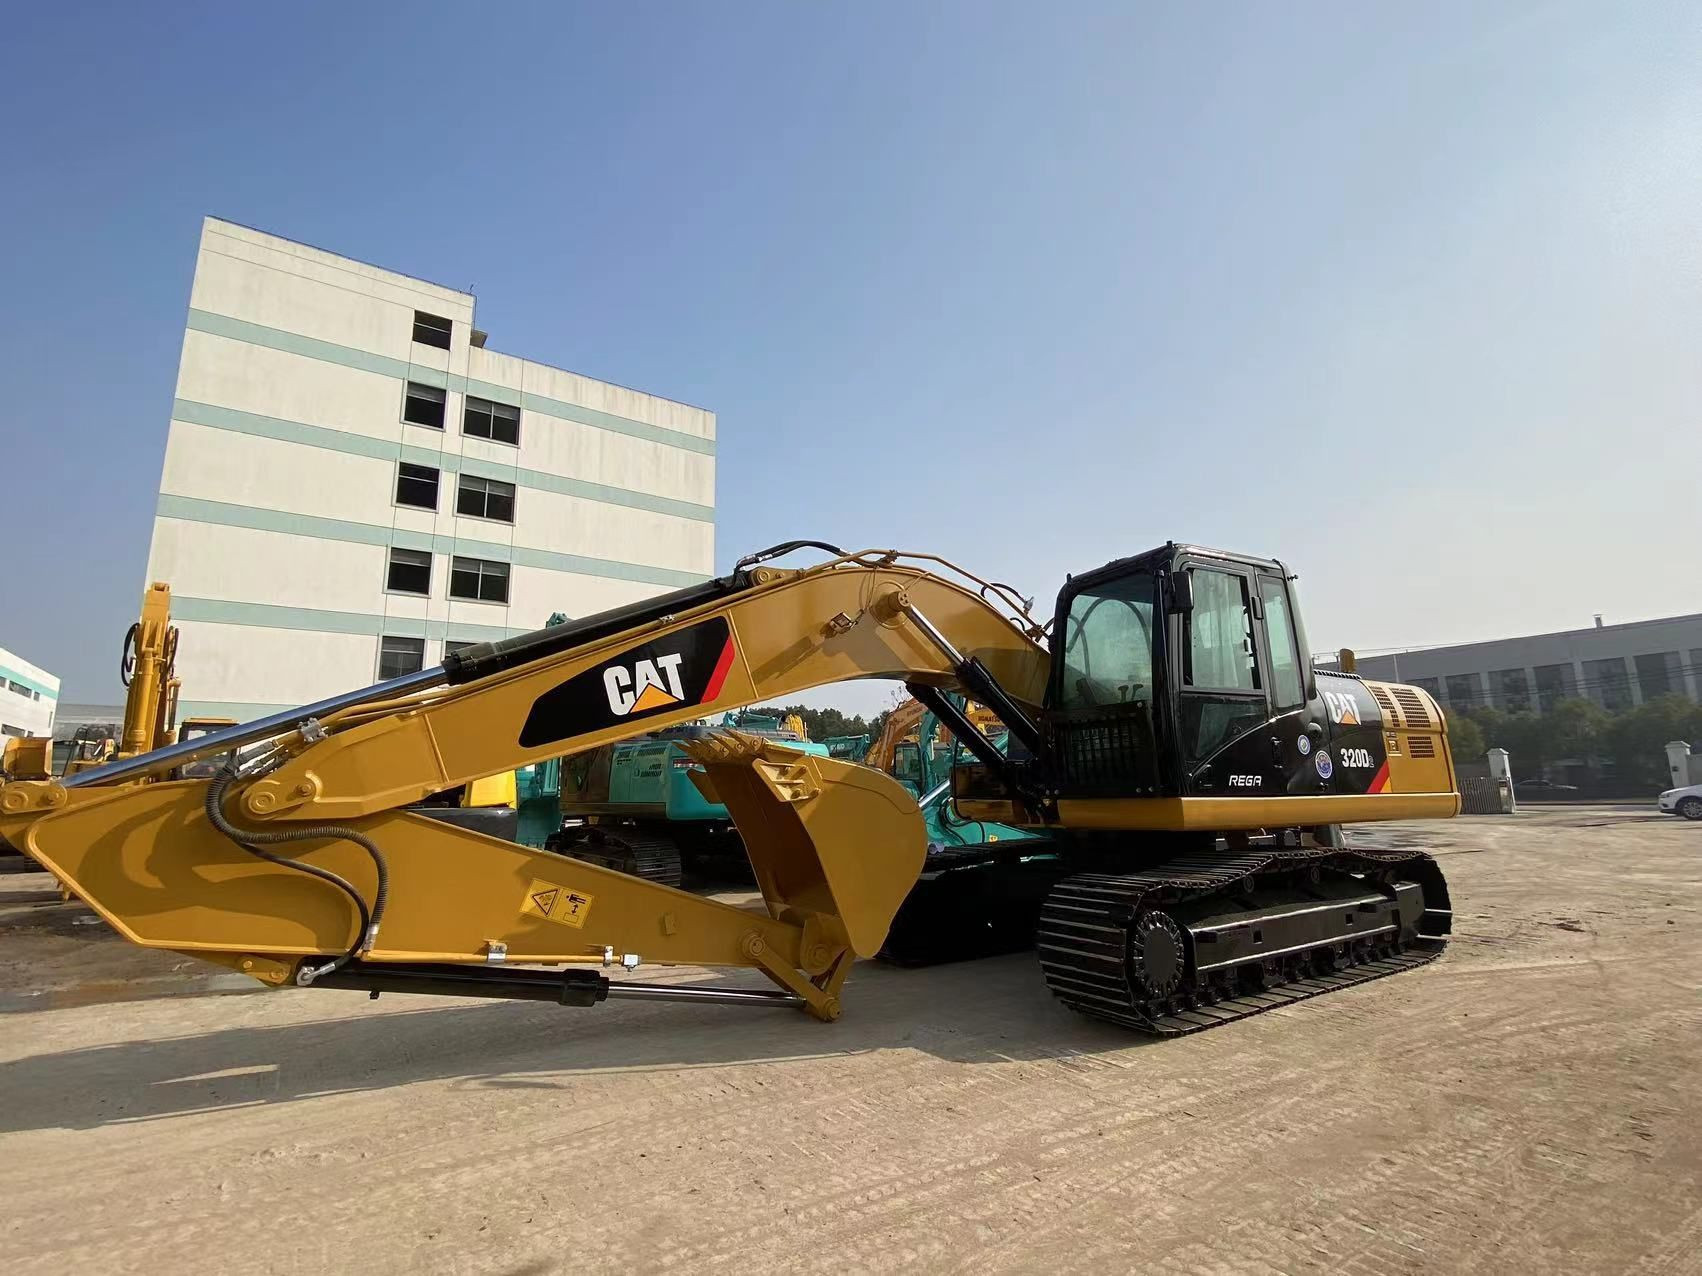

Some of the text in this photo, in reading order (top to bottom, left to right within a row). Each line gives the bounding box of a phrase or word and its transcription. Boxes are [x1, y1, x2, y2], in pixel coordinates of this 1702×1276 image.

[603, 653, 685, 716] CAT
[1325, 691, 1362, 725] CAT
[1228, 775, 1262, 787] REGA
